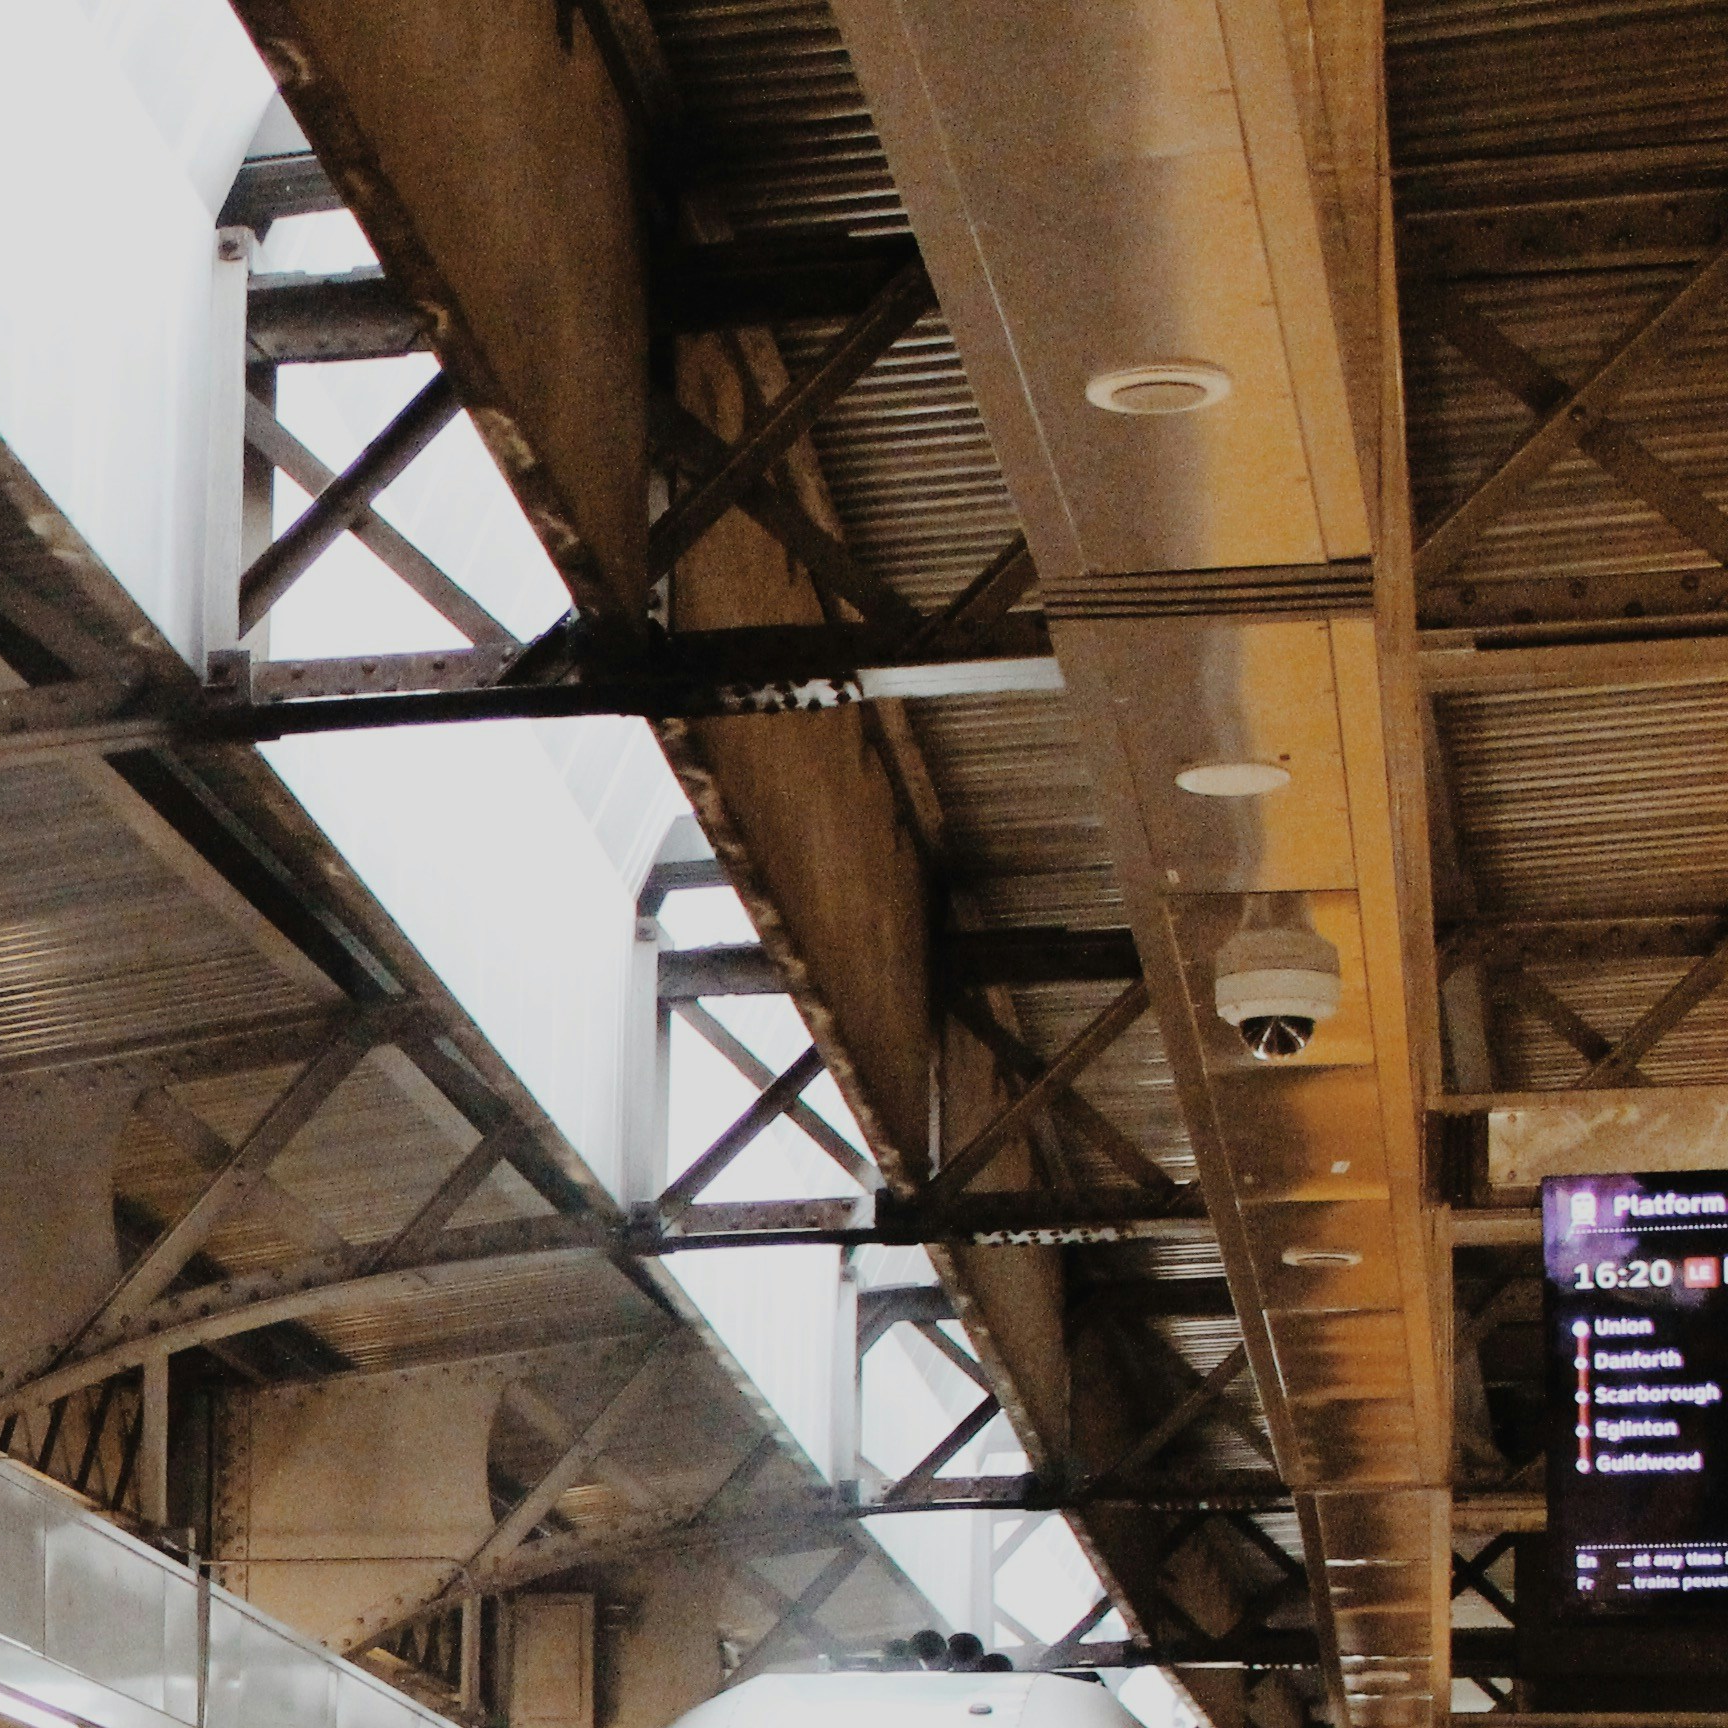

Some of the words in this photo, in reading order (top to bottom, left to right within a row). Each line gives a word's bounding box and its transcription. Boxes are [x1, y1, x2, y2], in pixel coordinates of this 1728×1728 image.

[1613, 1192, 1726, 1217] Platform
[1573, 1259, 1673, 1290] 16:20
[1689, 1266, 1712, 1280] LE
[1594, 1318, 1653, 1336] Union
[1594, 1350, 1683, 1370] Danforth
[1595, 1383, 1721, 1405] Scarborough
[1595, 1420, 1679, 1441] Eglinton
[1596, 1451, 1702, 1472] Guildwood
[1576, 1554, 1598, 1568] En
[1633, 1554, 1651, 1568] at
[1653, 1555, 1684, 1570] any
[1686, 1552, 1723, 1567] time
[1577, 1577, 1595, 1590] Fr
[1633, 1575, 1680, 1589] trains
